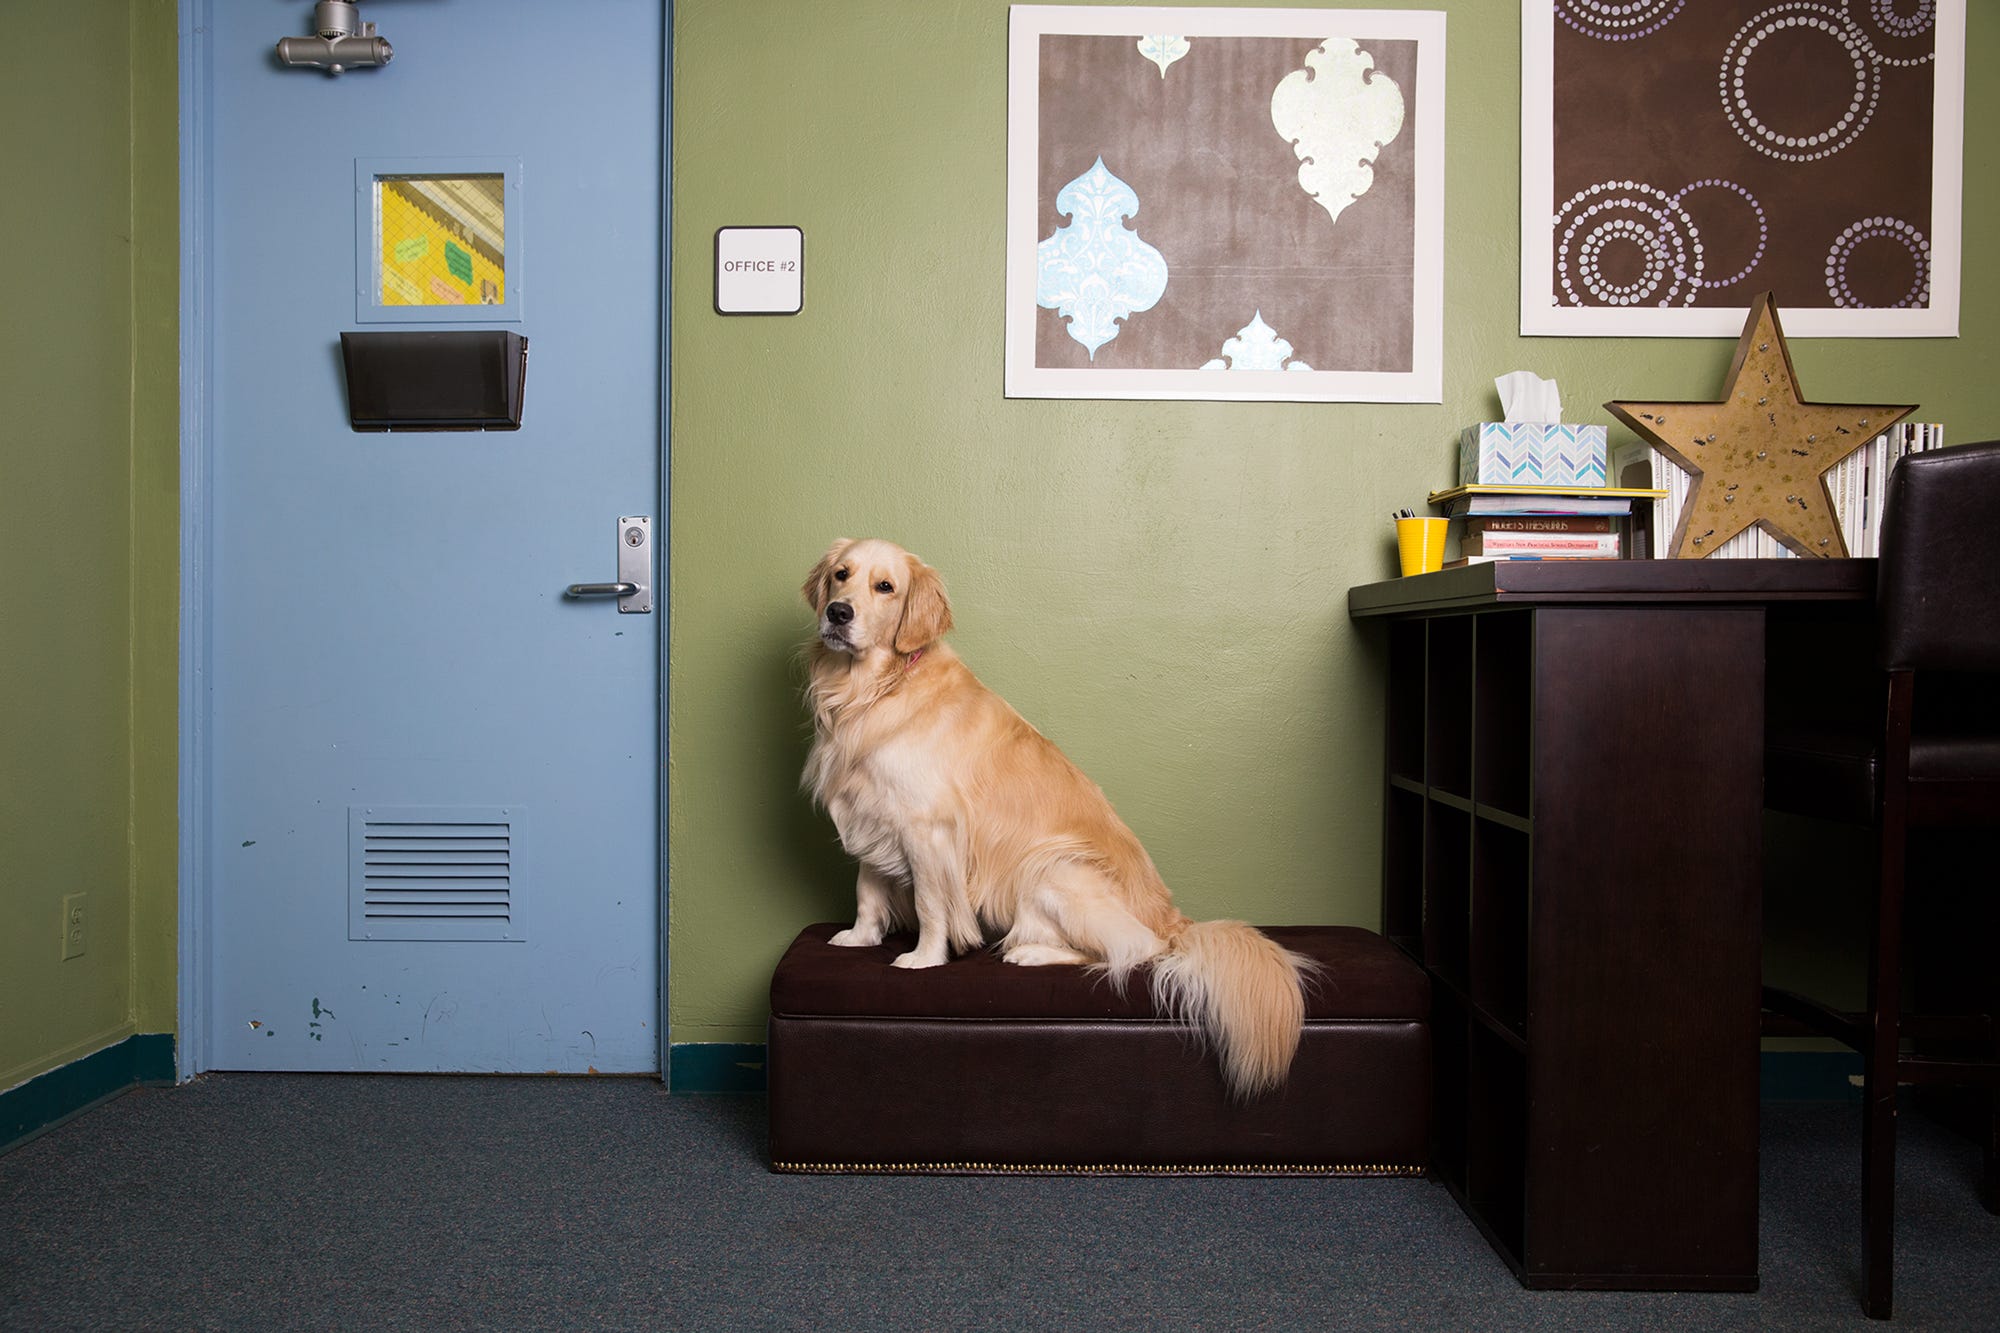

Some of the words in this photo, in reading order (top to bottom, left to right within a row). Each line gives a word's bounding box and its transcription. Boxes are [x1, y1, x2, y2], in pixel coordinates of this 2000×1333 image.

[724, 260, 775, 272] OFFICE
[780, 260, 796, 272] #2
[1525, 520, 1569, 530] THESAURUS
